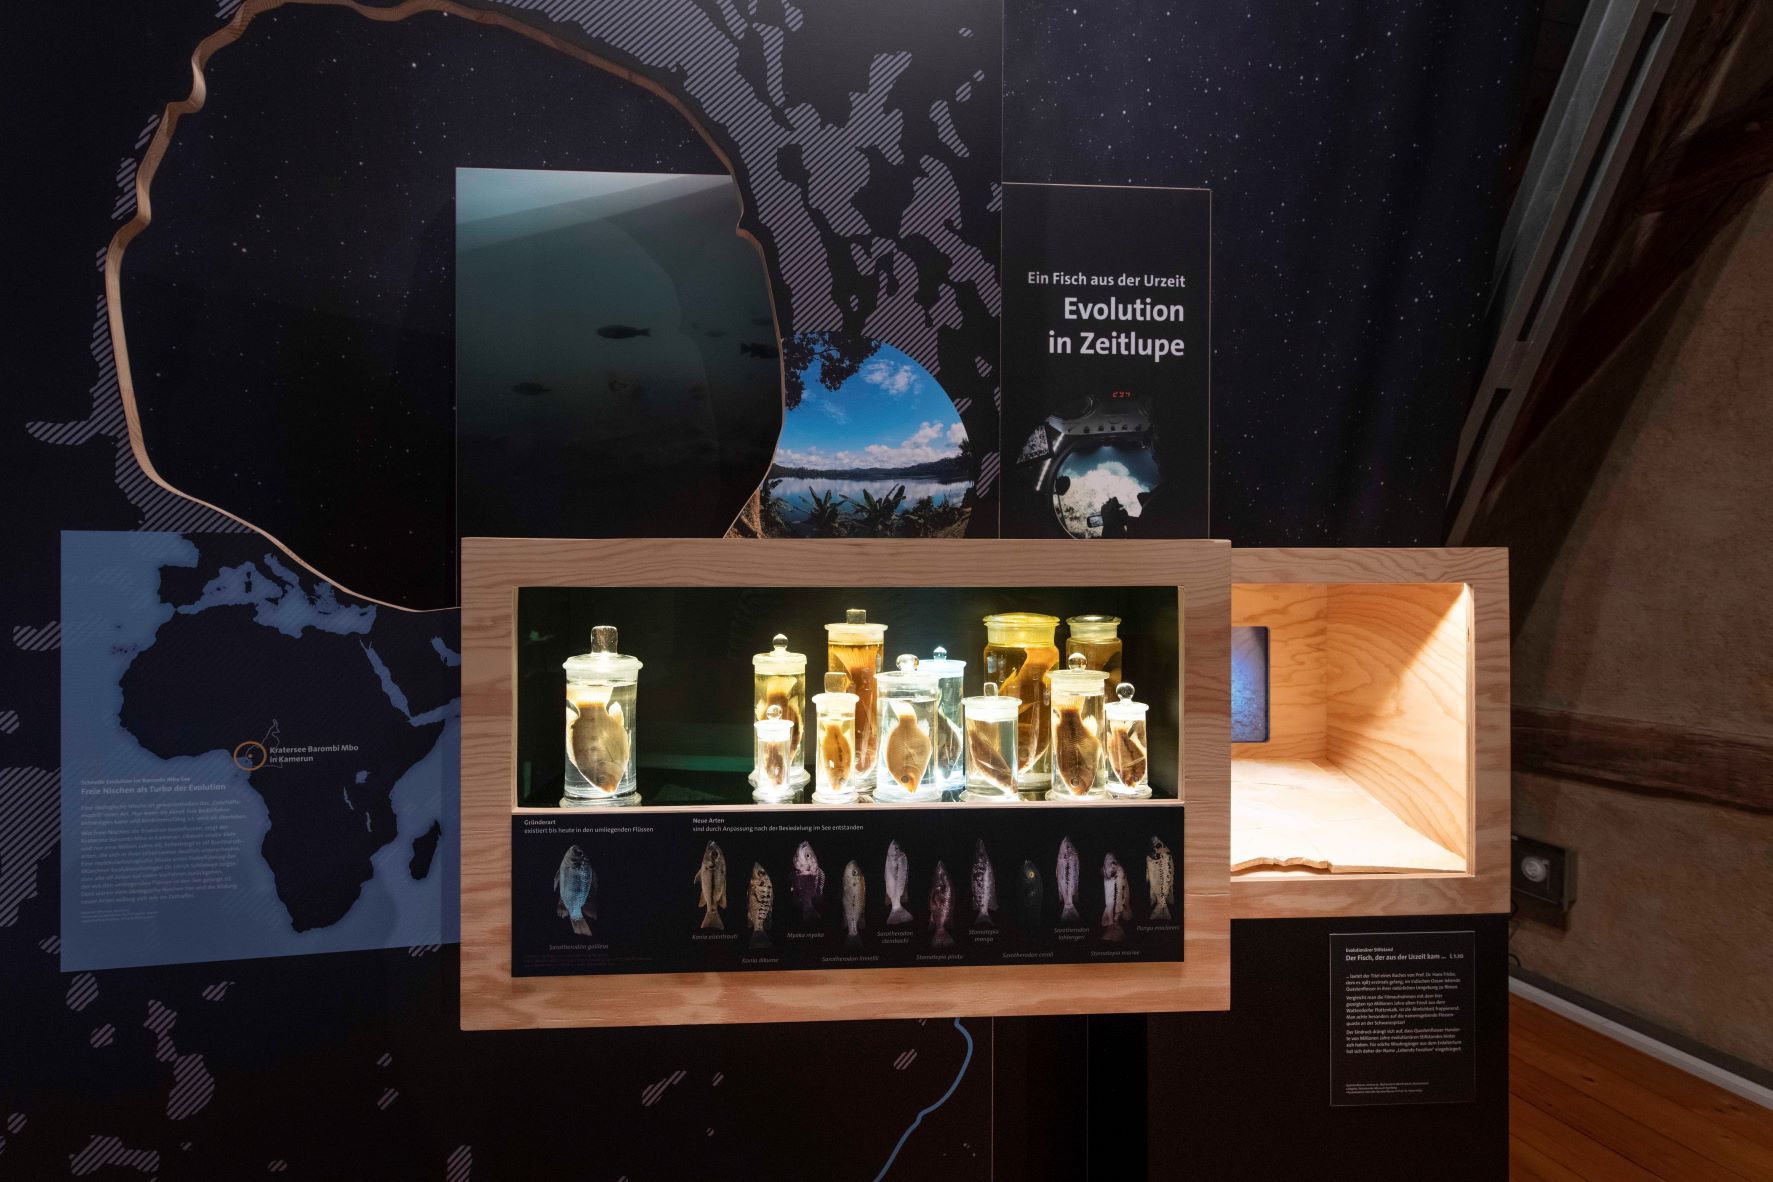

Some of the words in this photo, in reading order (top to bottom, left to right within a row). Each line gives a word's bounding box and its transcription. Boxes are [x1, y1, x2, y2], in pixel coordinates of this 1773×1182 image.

[1028, 272, 1048, 284] Ein
[1053, 272, 1086, 285] Fisch
[1091, 276, 1114, 286] aus
[1118, 274, 1140, 286] der
[1144, 275, 1186, 288] Urzeit
[1064, 297, 1184, 322] Evolution
[1049, 330, 1072, 354] in
[1080, 332, 1185, 362] Zeitlupe
[308, 744, 340, 752] Barombi
[1357, 954, 1374, 962] Fisch,
